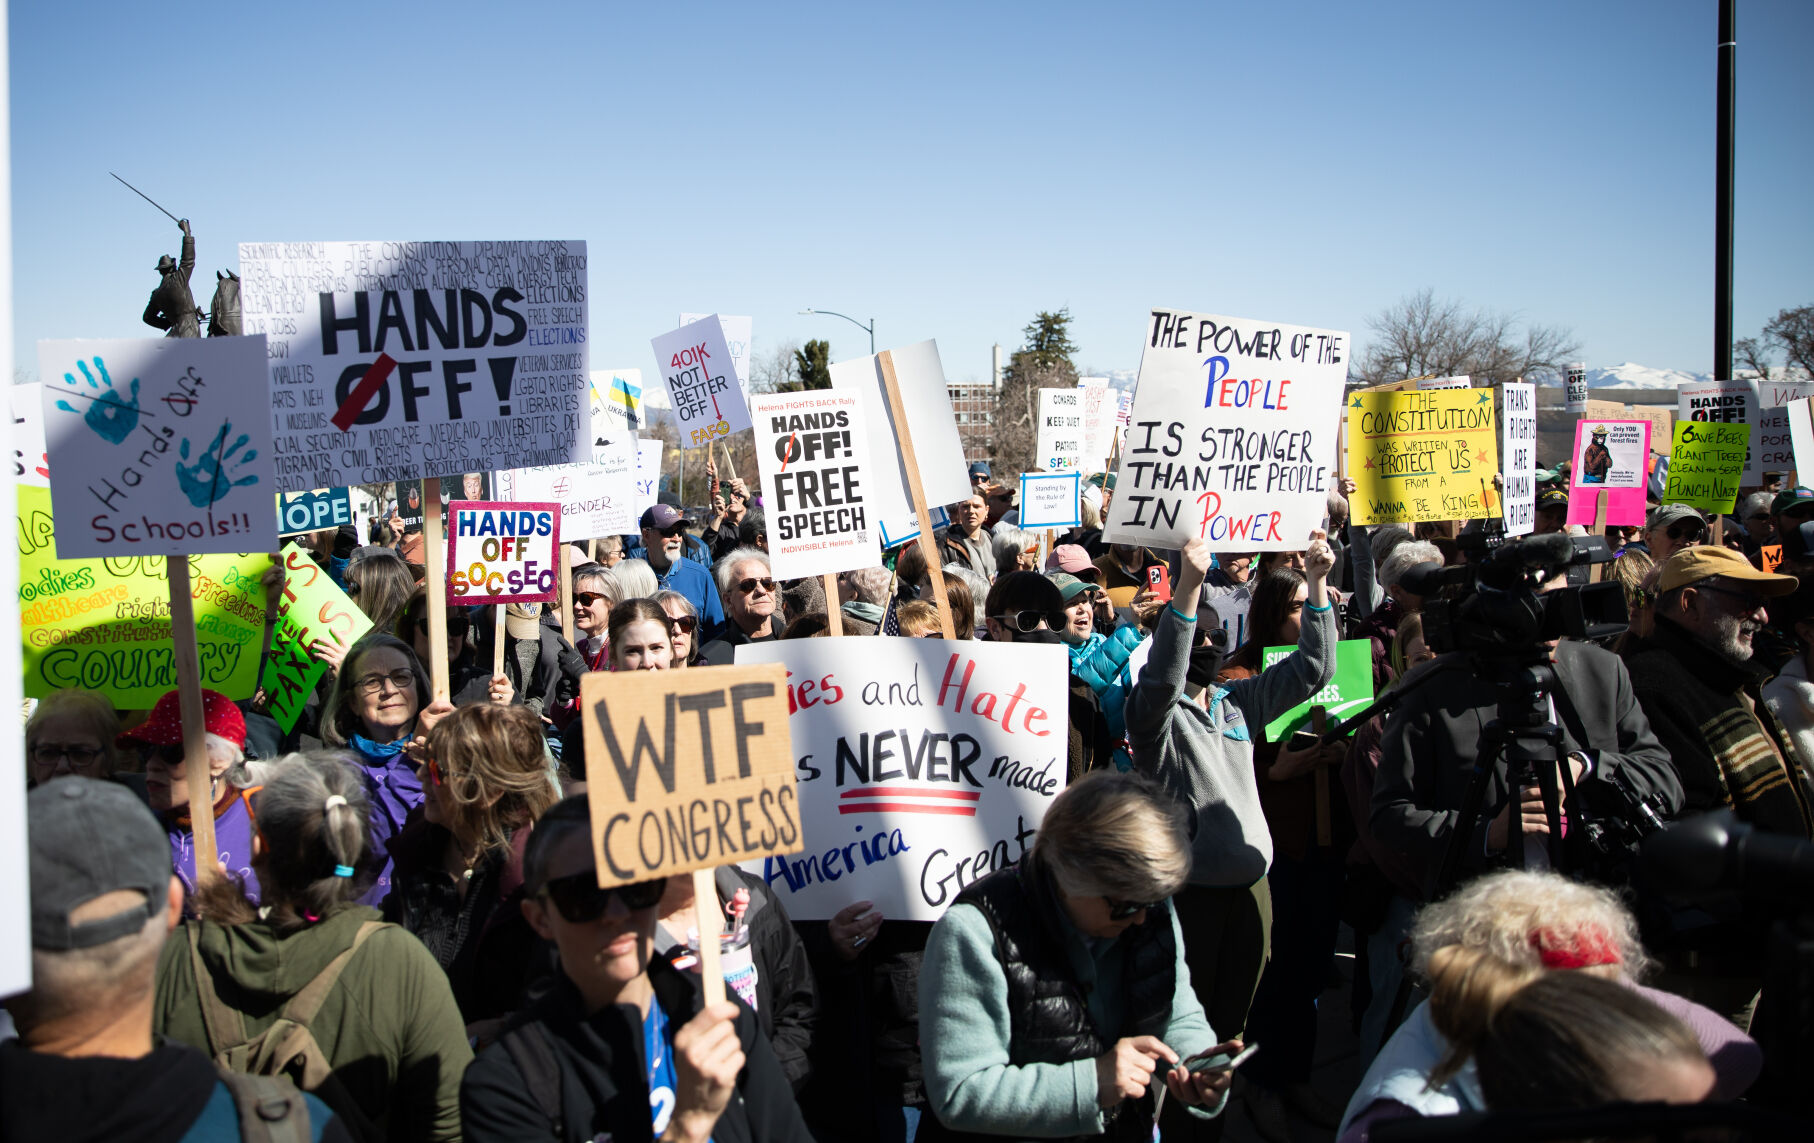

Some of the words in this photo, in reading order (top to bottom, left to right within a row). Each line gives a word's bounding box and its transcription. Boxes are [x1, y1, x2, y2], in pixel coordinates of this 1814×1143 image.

[349, 243, 373, 260] THE
[382, 241, 461, 260] CONSTITUTION
[475, 241, 533, 258] DIPLOMATIC
[538, 240, 568, 256] CORPS
[282, 261, 334, 279] COLLEGES
[345, 260, 383, 278] PUBLIC
[391, 259, 427, 277] LANDS
[436, 257, 484, 274] PERSONAL
[487, 256, 511, 274] DATA
[517, 256, 551, 272] UNIONS
[245, 278, 287, 294] FOREIGN
[356, 275, 426, 292] INTERNATIONAL
[432, 273, 479, 291] ALLIANCES
[485, 272, 514, 289] CLEAN
[518, 271, 552, 290] ENERGY
[556, 270, 577, 286] TECH
[527, 285, 584, 304] ELECTIONS
[272, 317, 297, 335] JOBS
[319, 287, 527, 355] HANDS
[528, 309, 548, 325] FREE
[552, 307, 583, 325] SPEECH
[529, 327, 586, 346] ELECTIONS
[1151, 312, 1192, 348] THE
[1197, 320, 1281, 361] POWER
[1291, 333, 1313, 363] OF
[1317, 335, 1343, 365] THE
[551, 353, 582, 372] SERVICES
[670, 342, 711, 370] 401K
[273, 365, 314, 384] WALLETS
[514, 376, 547, 395] LGBTQ
[550, 374, 585, 392] RIGHTS
[669, 366, 700, 392] NOT
[1202, 355, 1291, 410] PEOPLE
[272, 390, 297, 409] ARTS
[303, 389, 324, 407] NEH
[335, 355, 516, 425] OFF!
[674, 375, 728, 407] BETTER
[1506, 390, 1529, 411] TRANS
[520, 395, 580, 414] LIBRARIES
[679, 400, 708, 422] OFF
[758, 404, 784, 412] Helena
[786, 400, 814, 409] FIGHTS
[817, 398, 837, 407] BACK
[839, 397, 856, 406] Rally
[1403, 392, 1437, 410] THE
[1691, 396, 1745, 408] HANDS
[287, 413, 328, 430] MUSEUMS
[771, 410, 849, 434] HANDS
[1361, 407, 1491, 434] CONSTITUTION
[1691, 407, 1745, 423] OFF!
[88, 424, 175, 512] Hands
[163, 366, 206, 417] Off
[306, 431, 357, 451] SECURITY
[369, 426, 421, 447] MEDICARE
[430, 421, 480, 443] MEDICAID
[487, 415, 557, 440] UNIVERSITIES
[564, 413, 580, 431] DEI
[1510, 418, 1535, 439] RIGHTS
[1716, 428, 1744, 445] BEES
[341, 450, 371, 468] CIVIL
[375, 446, 412, 466] RIGHTS
[423, 441, 469, 461] COURTS
[481, 436, 537, 456] RESEARCH
[551, 432, 576, 450] NOAA
[775, 430, 853, 464] OFF!
[1132, 421, 1185, 458] IS
[1199, 427, 1313, 463] STRONGER
[1376, 442, 1398, 454] WAS
[1404, 440, 1448, 452] WRITTEN
[1379, 451, 1435, 474] PROTECT
[1449, 449, 1471, 470] US
[1514, 449, 1527, 470] ARE
[1675, 445, 1710, 461] PLANT
[1710, 450, 1743, 462] TREES
[314, 469, 342, 489] NATO
[362, 464, 419, 484] CONSUMER
[424, 458, 493, 477] PROTECTIONS
[1127, 461, 1211, 492] THAN
[1218, 464, 1261, 492] THE
[1267, 462, 1326, 494] PEOPLE
[1670, 462, 1703, 473] CLEAN
[774, 465, 863, 512] FREE
[1060, 484, 1067, 492] by
[1405, 476, 1429, 490] FROM
[1440, 476, 1446, 486] A
[1506, 476, 1529, 499] HUMAN
[1668, 476, 1709, 498] PUNCH
[562, 496, 612, 517] GENDER
[1368, 498, 1407, 515] WANNA
[1412, 498, 1430, 511] BE
[1442, 494, 1479, 511] KING
[459, 511, 551, 537] HANDS
[778, 506, 866, 541] SPEECH
[1122, 496, 1182, 530] IN
[1196, 491, 1282, 542] POWER
[1510, 504, 1534, 527] RIGHTS
[92, 513, 249, 543] Schools!!
[482, 536, 529, 562] OFF
[781, 542, 827, 554] INDIVISIBLE
[829, 539, 854, 548] Helena
[18, 567, 95, 602] odies
[269, 618, 299, 668] ARE
[786, 672, 844, 715] ies
[862, 663, 923, 707] and
[936, 652, 1050, 737] Hate
[594, 683, 775, 803] WTF
[836, 729, 984, 788] NEVER
[988, 752, 1057, 796] made
[764, 825, 911, 893] America
[920, 815, 1036, 907] Great
